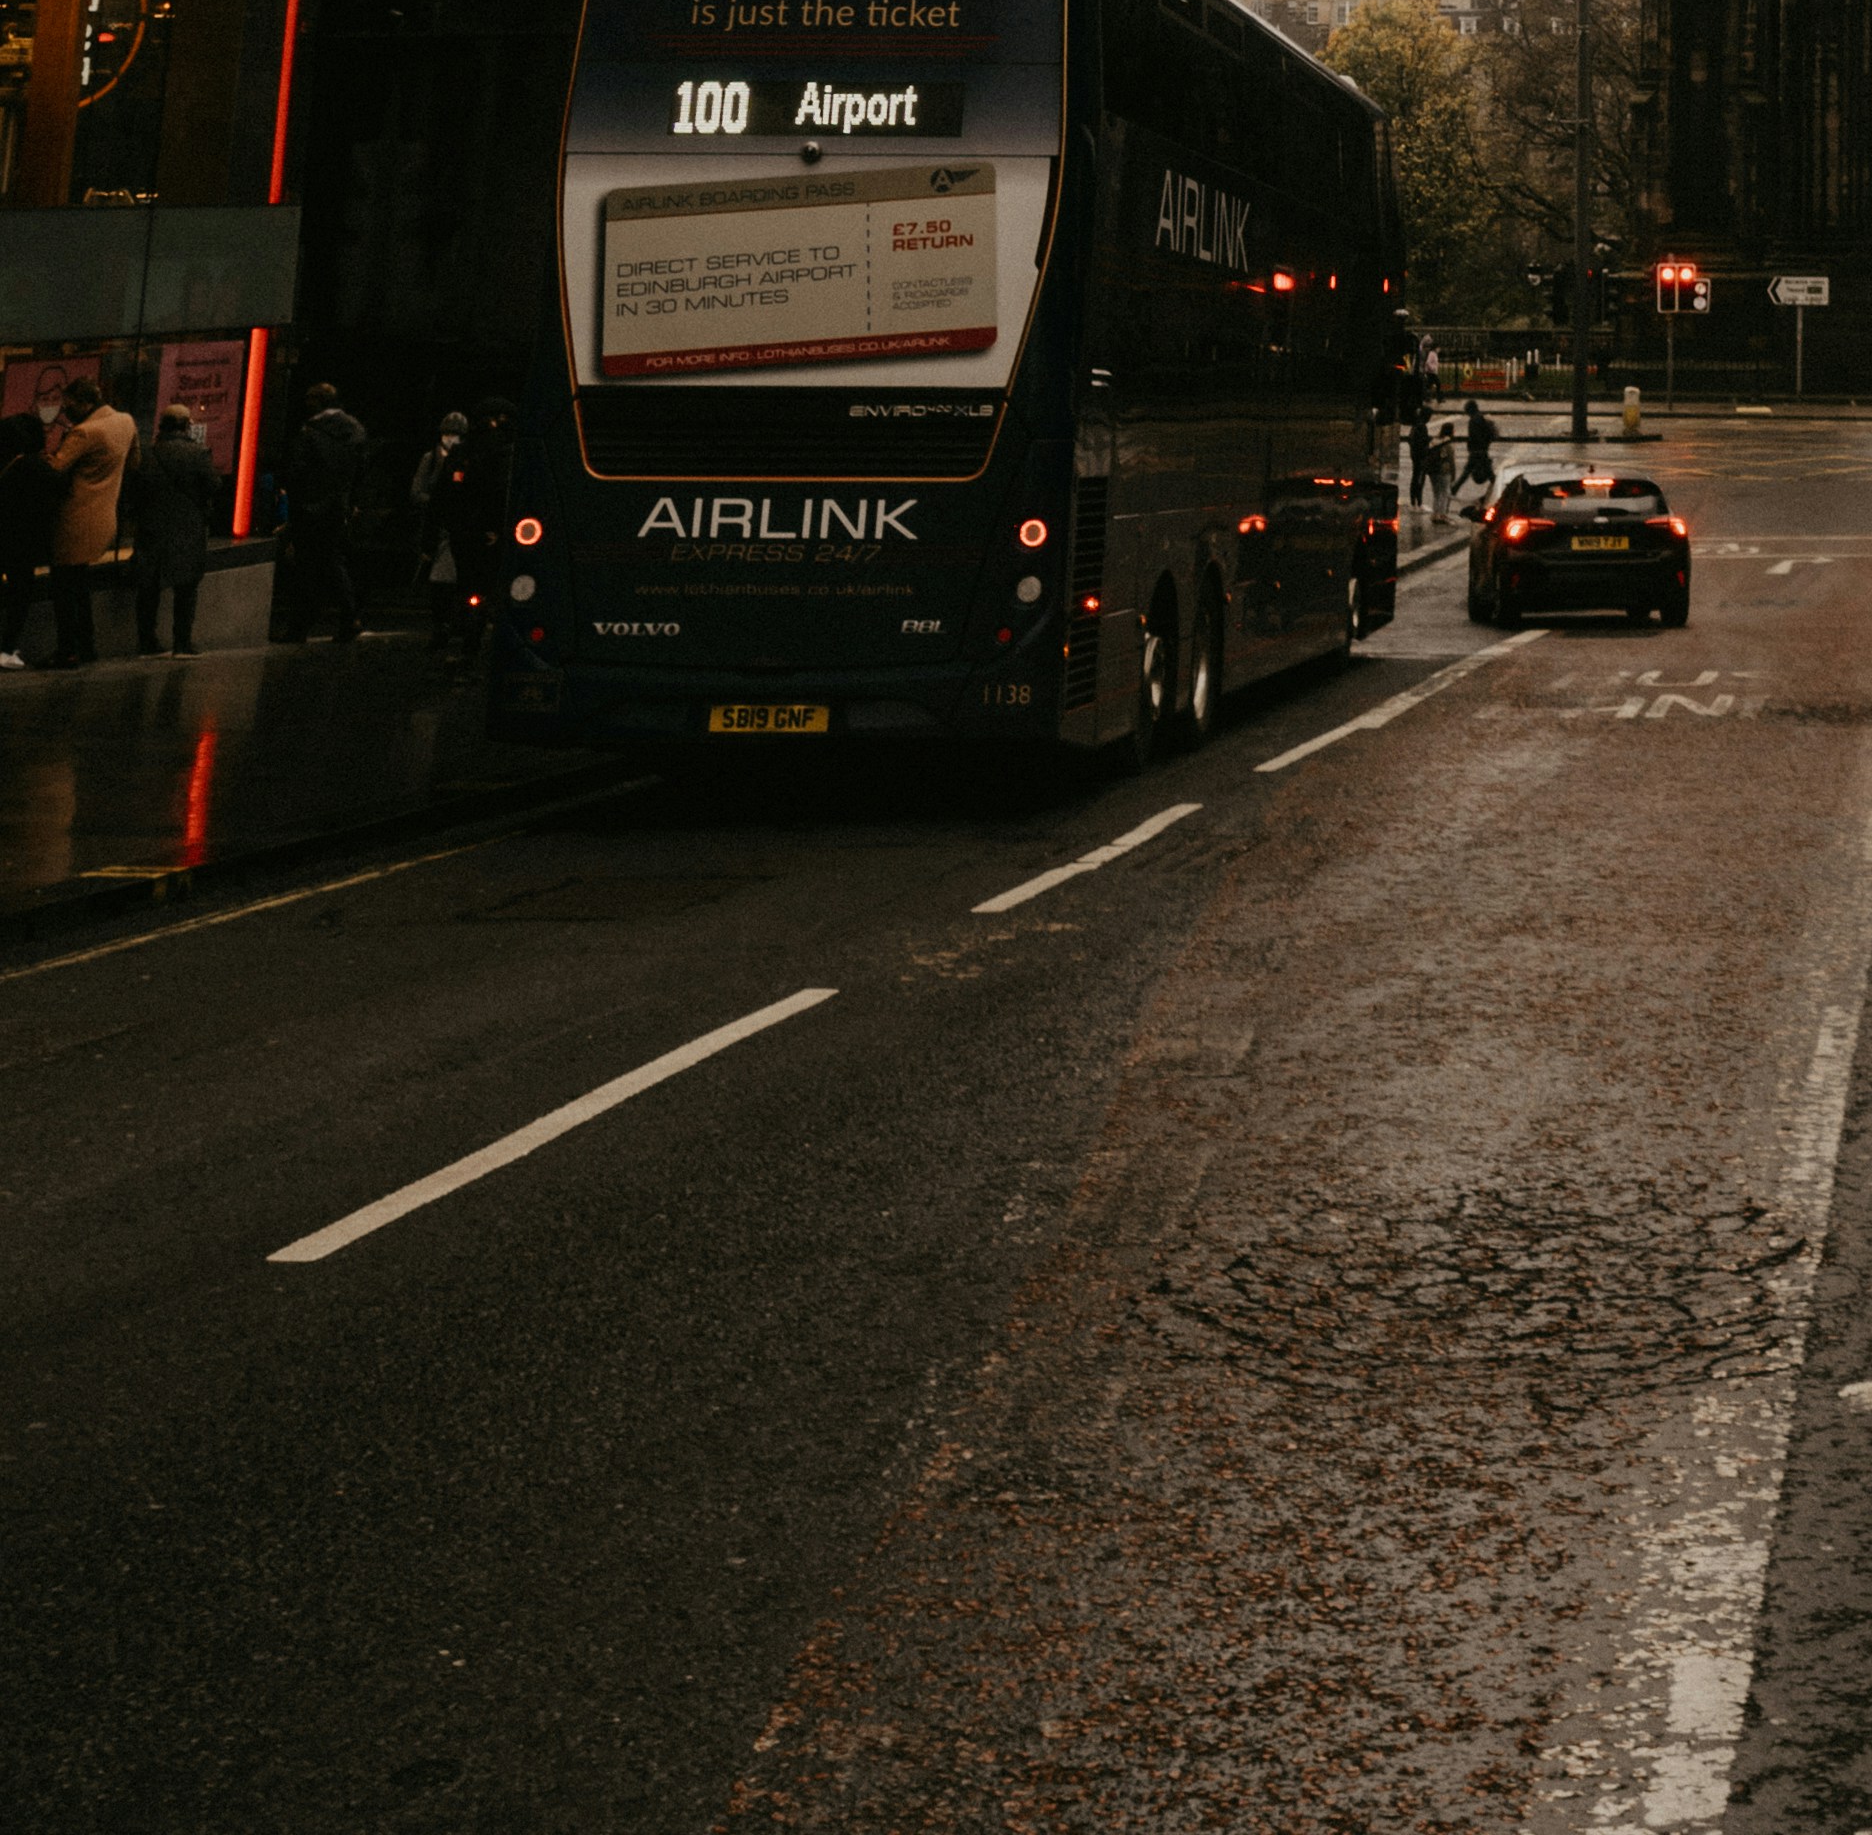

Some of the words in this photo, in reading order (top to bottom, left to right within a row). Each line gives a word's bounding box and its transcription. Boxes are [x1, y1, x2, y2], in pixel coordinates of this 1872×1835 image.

[672, 81, 751, 135] 100
[795, 81, 918, 135] Airport
[621, 193, 693, 212] AIRLINK
[699, 186, 800, 206] BOARDING
[805, 181, 856, 200] PASS
[893, 220, 952, 237] £7.50
[1155, 169, 1251, 273] AIRLINK
[892, 234, 974, 252] RETURN
[616, 257, 698, 278] DIRECT
[705, 248, 801, 271] SERVICE
[809, 245, 841, 262] TO
[616, 273, 752, 298] EDINBURGH
[758, 263, 858, 284] AIRPORT
[616, 301, 639, 317] IN
[645, 298, 678, 315] 30
[684, 288, 790, 312] MINUTES
[646, 356, 673, 368] FOR
[676, 353, 716, 367] MORE
[636, 496, 919, 541] AIRLINK
[670, 543, 805, 564] EXPRESS
[814, 543, 882, 564] 24/7
[592, 620, 681, 637] VOLVO
[982, 683, 1032, 706] 1138
[721, 707, 769, 729] SB19
[774, 707, 816, 729] GNF
